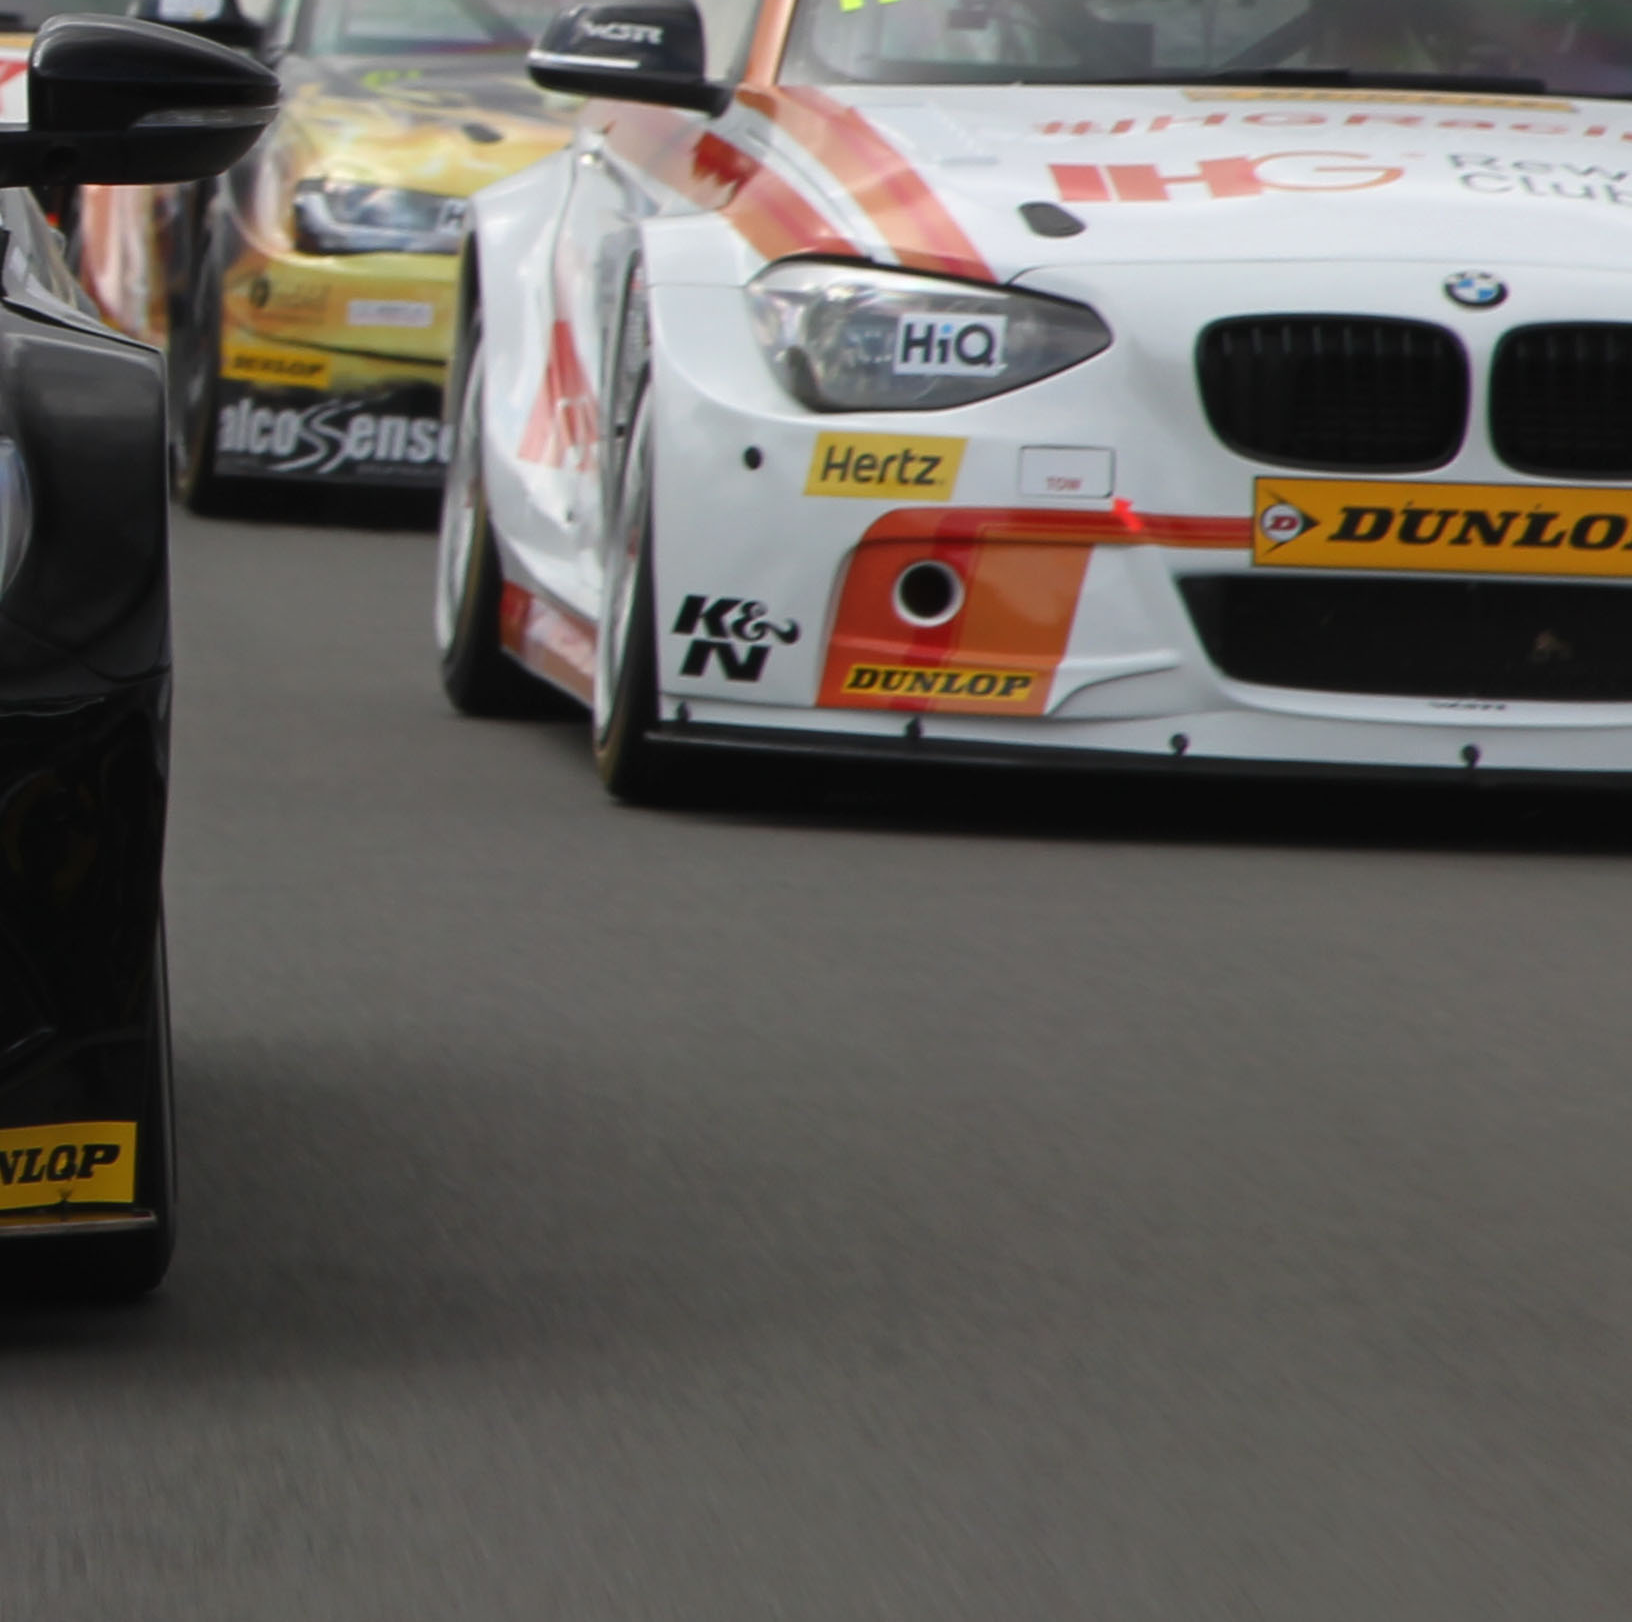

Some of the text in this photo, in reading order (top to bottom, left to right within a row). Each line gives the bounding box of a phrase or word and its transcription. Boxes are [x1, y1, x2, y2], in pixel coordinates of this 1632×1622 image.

[1047, 150, 1405, 203] IHG
[901, 322, 996, 367] HiQ
[218, 397, 450, 474] alcoSens
[820, 445, 942, 486] Hertz
[1327, 504, 1632, 551] DUNLO
[843, 668, 1032, 698] DUNLOP
